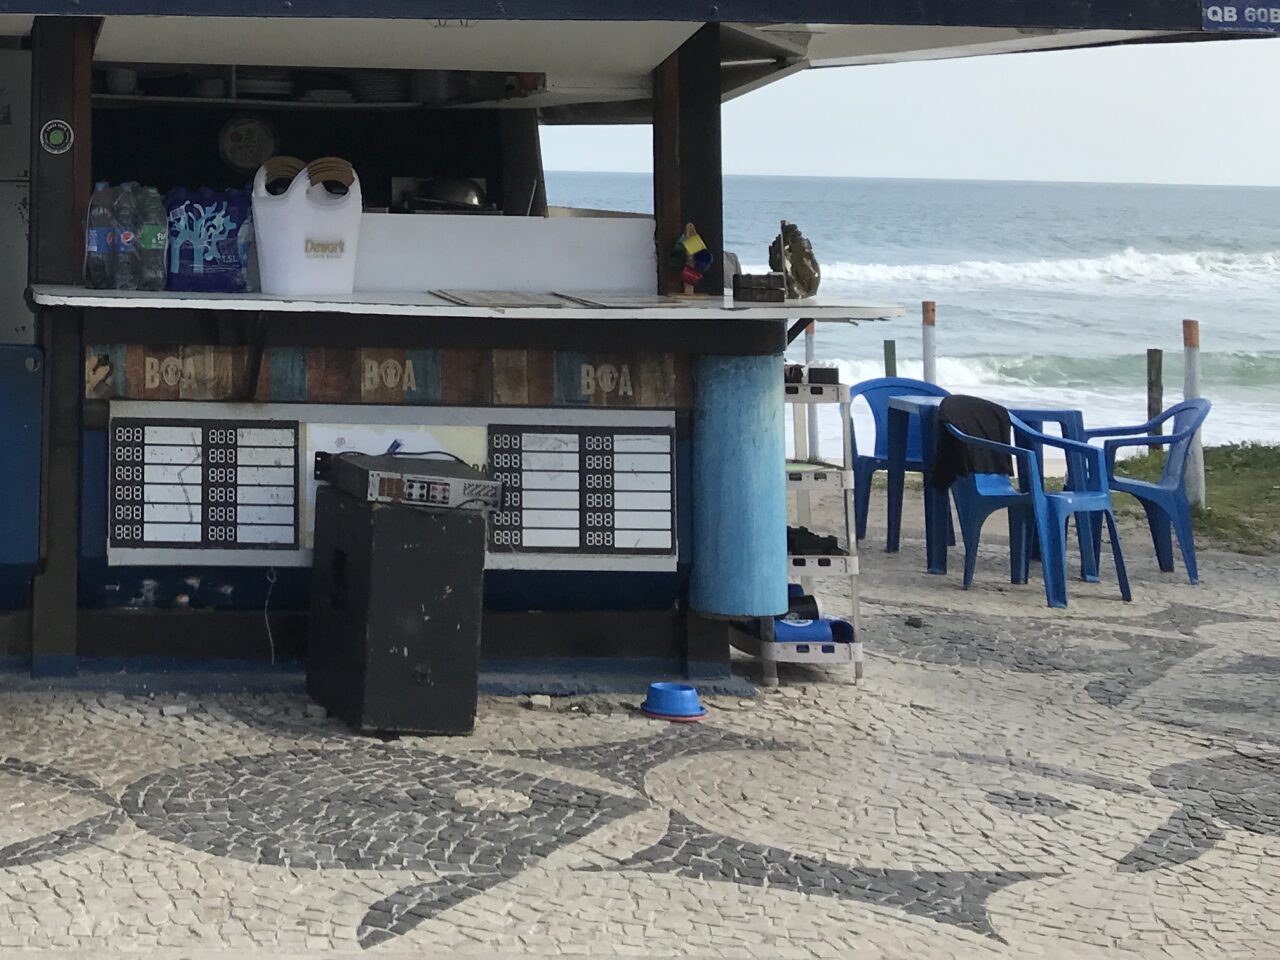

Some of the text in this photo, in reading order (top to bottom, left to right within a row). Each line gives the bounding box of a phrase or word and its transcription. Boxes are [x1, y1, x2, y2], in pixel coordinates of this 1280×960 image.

[1207, 5, 1238, 22] QB
[145, 356, 197, 389] BOA
[364, 359, 417, 392] BOA
[581, 364, 633, 396] BOA
[502, 492, 520, 506] 88
